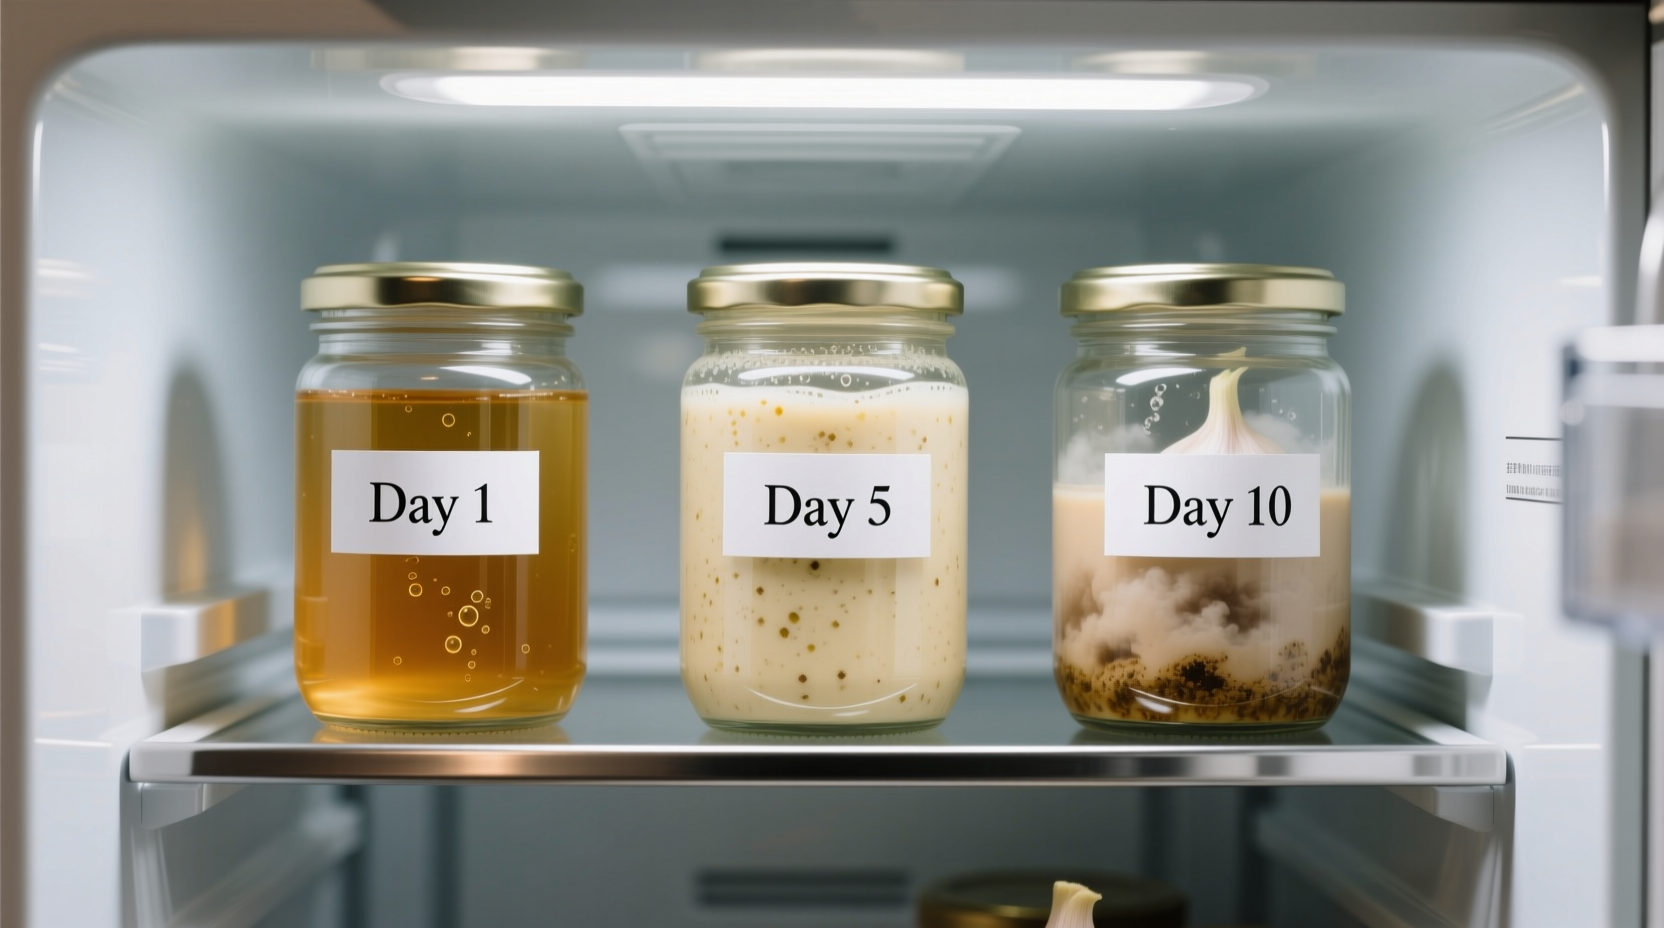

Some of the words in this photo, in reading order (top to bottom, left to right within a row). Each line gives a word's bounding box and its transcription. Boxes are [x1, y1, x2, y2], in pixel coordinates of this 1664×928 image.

[368, 481, 459, 537] Day
[474, 483, 493, 524] 1
[763, 484, 855, 540] Day
[867, 485, 891, 527] 5
[1143, 484, 1234, 539] Day
[1247, 484, 1292, 527] 10
